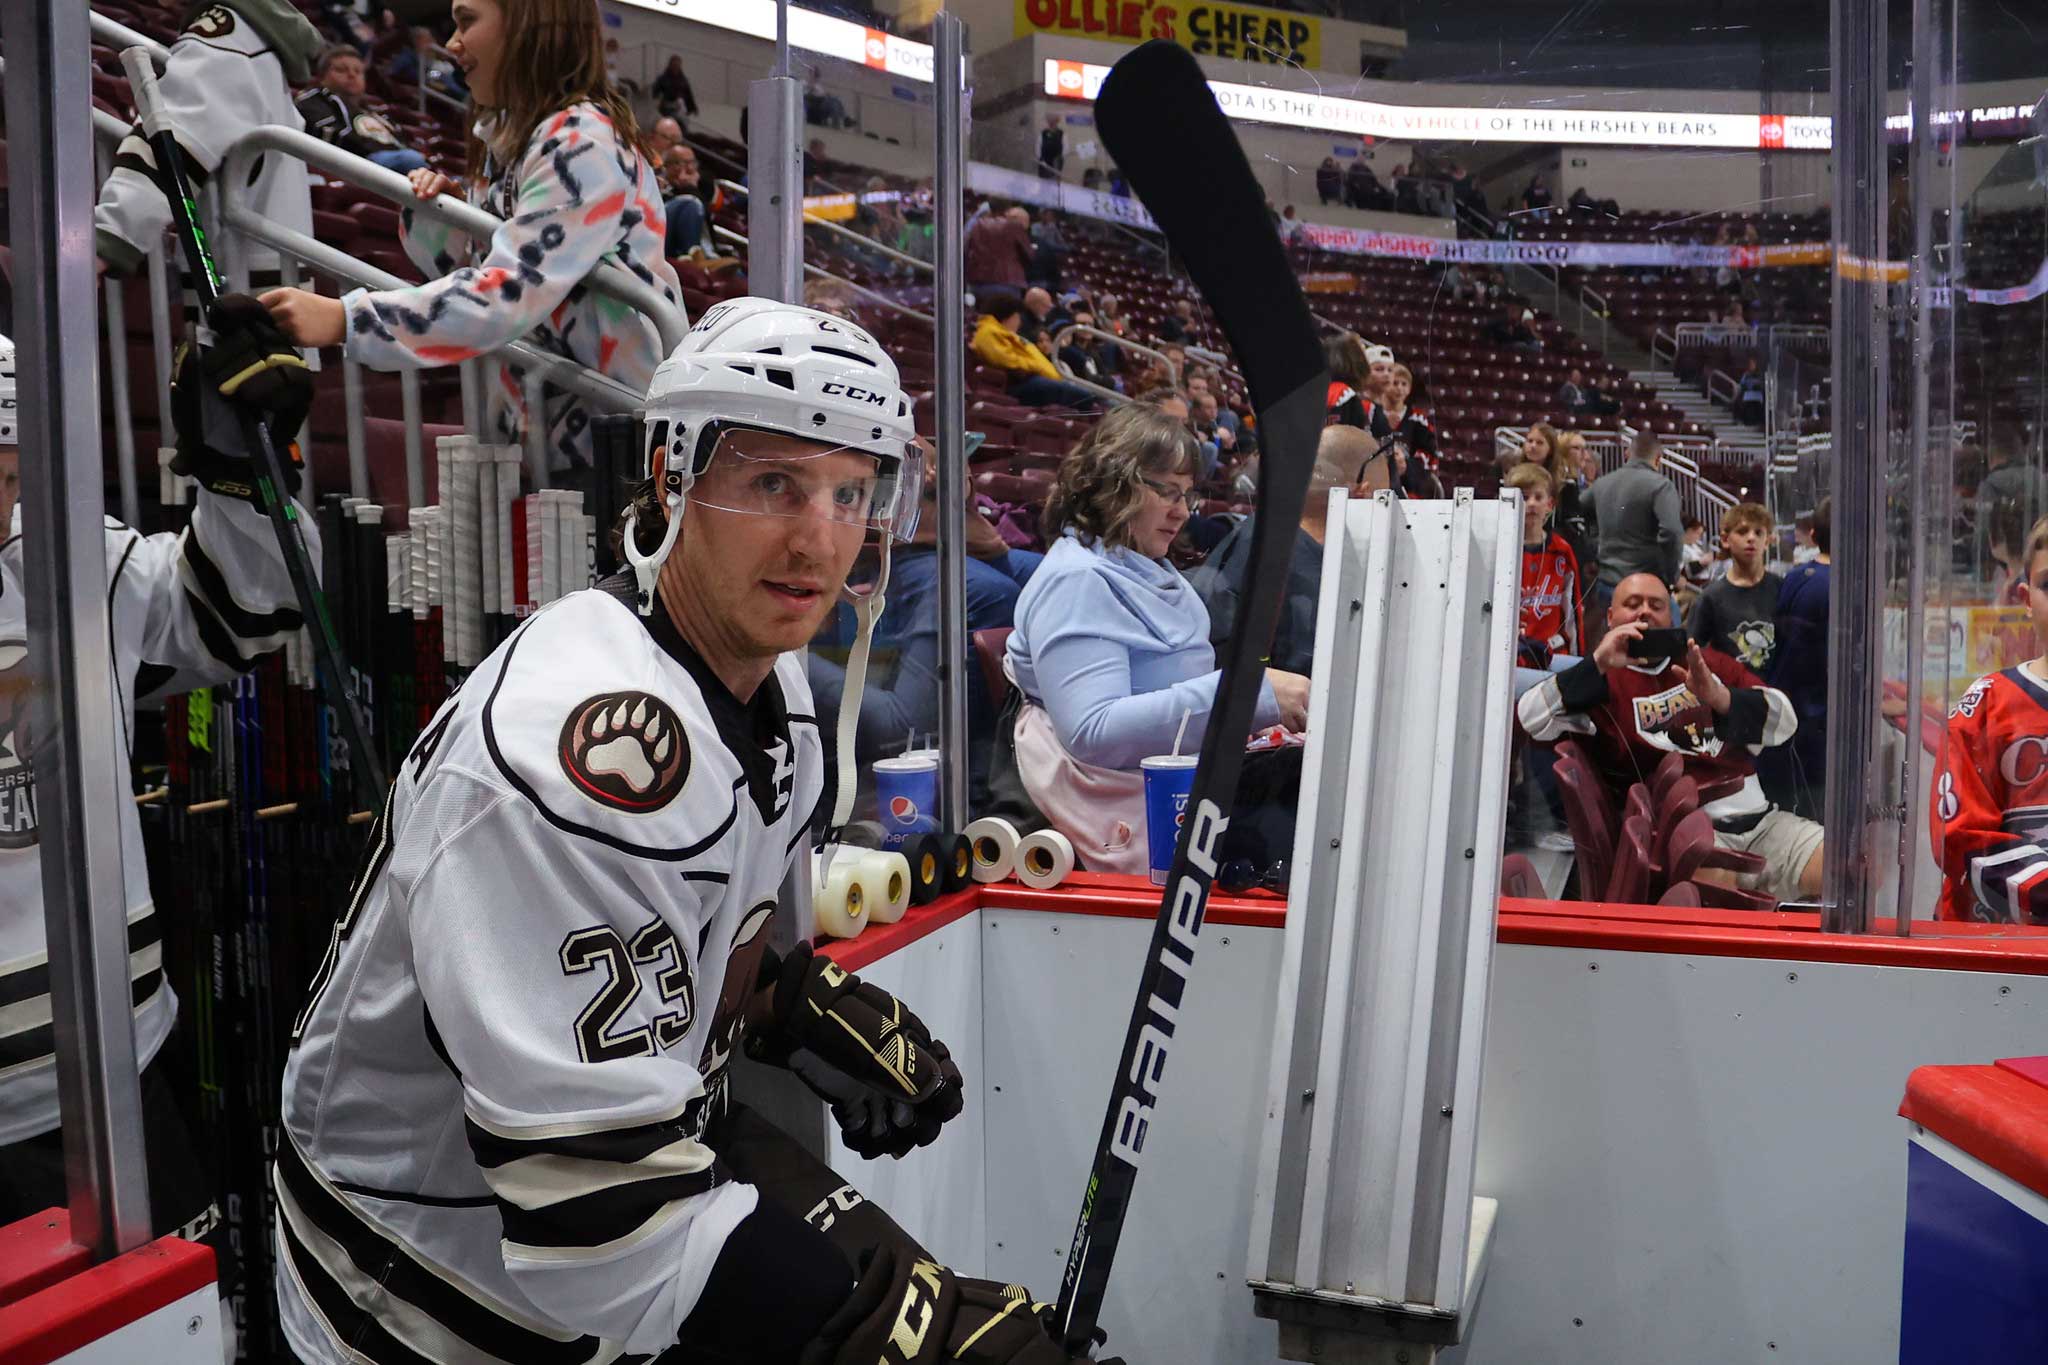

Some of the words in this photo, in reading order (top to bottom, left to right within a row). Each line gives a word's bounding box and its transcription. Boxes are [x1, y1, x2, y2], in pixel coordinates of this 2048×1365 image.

[1188, 7, 1310, 51] CHEAP
[1261, 92, 1277, 111] IS
[1284, 99, 1315, 117] THE
[1321, 105, 1396, 128] OFFICIAL
[1402, 114, 1481, 130] VEHICLE
[1490, 117, 1515, 131] OF
[1523, 118, 1557, 132] THE
[1563, 119, 1651, 134] HERSHEY
[1657, 121, 1718, 136] BEARS
[821, 381, 887, 407] CCM
[558, 914, 697, 1064] 23
[1110, 798, 1231, 1171] BAUER
[1065, 1171, 1099, 1288] HYPERLITE
